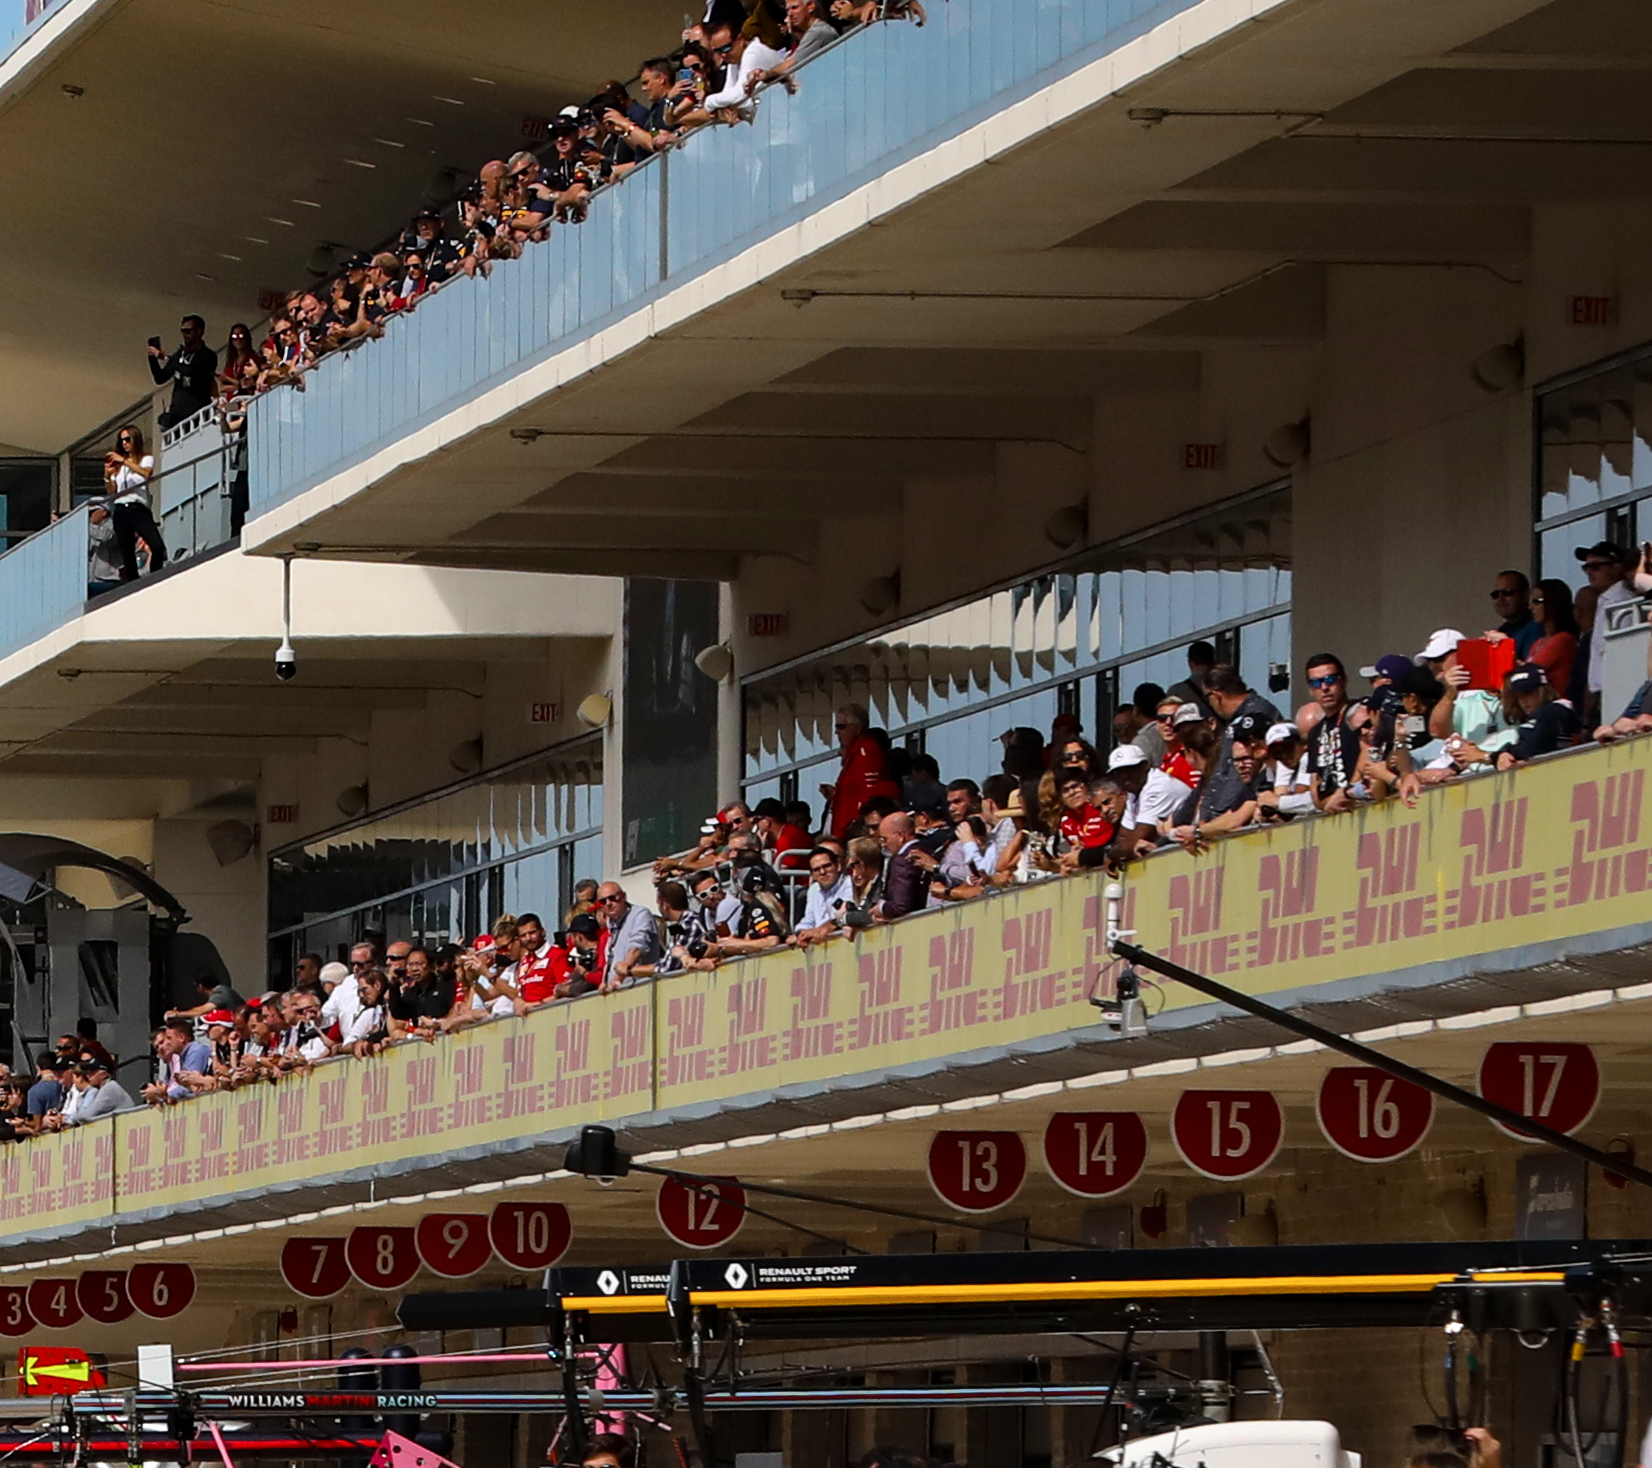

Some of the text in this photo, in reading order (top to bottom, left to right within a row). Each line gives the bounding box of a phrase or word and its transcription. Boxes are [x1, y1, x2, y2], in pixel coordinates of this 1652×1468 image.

[1518, 1055, 1568, 1118] 17
[1353, 1079, 1400, 1139] 16
[1205, 1101, 1251, 1158] 15
[957, 1140, 999, 1194] 13
[1073, 1123, 1117, 1177] 14
[442, 1220, 469, 1259] 9
[512, 1210, 549, 1255] 10
[310, 1245, 328, 1284] 7
[376, 1234, 394, 1275] 8
[759, 1265, 857, 1277] RENAULT SPORT
[103, 1277, 119, 1312] 5
[152, 1267, 169, 1306] 6
[630, 1274, 671, 1283] RENAU
[6, 1292, 22, 1326] 3
[50, 1285, 67, 1317] 4
[228, 1394, 437, 1408] WILLIAMS MARTINI RACING
